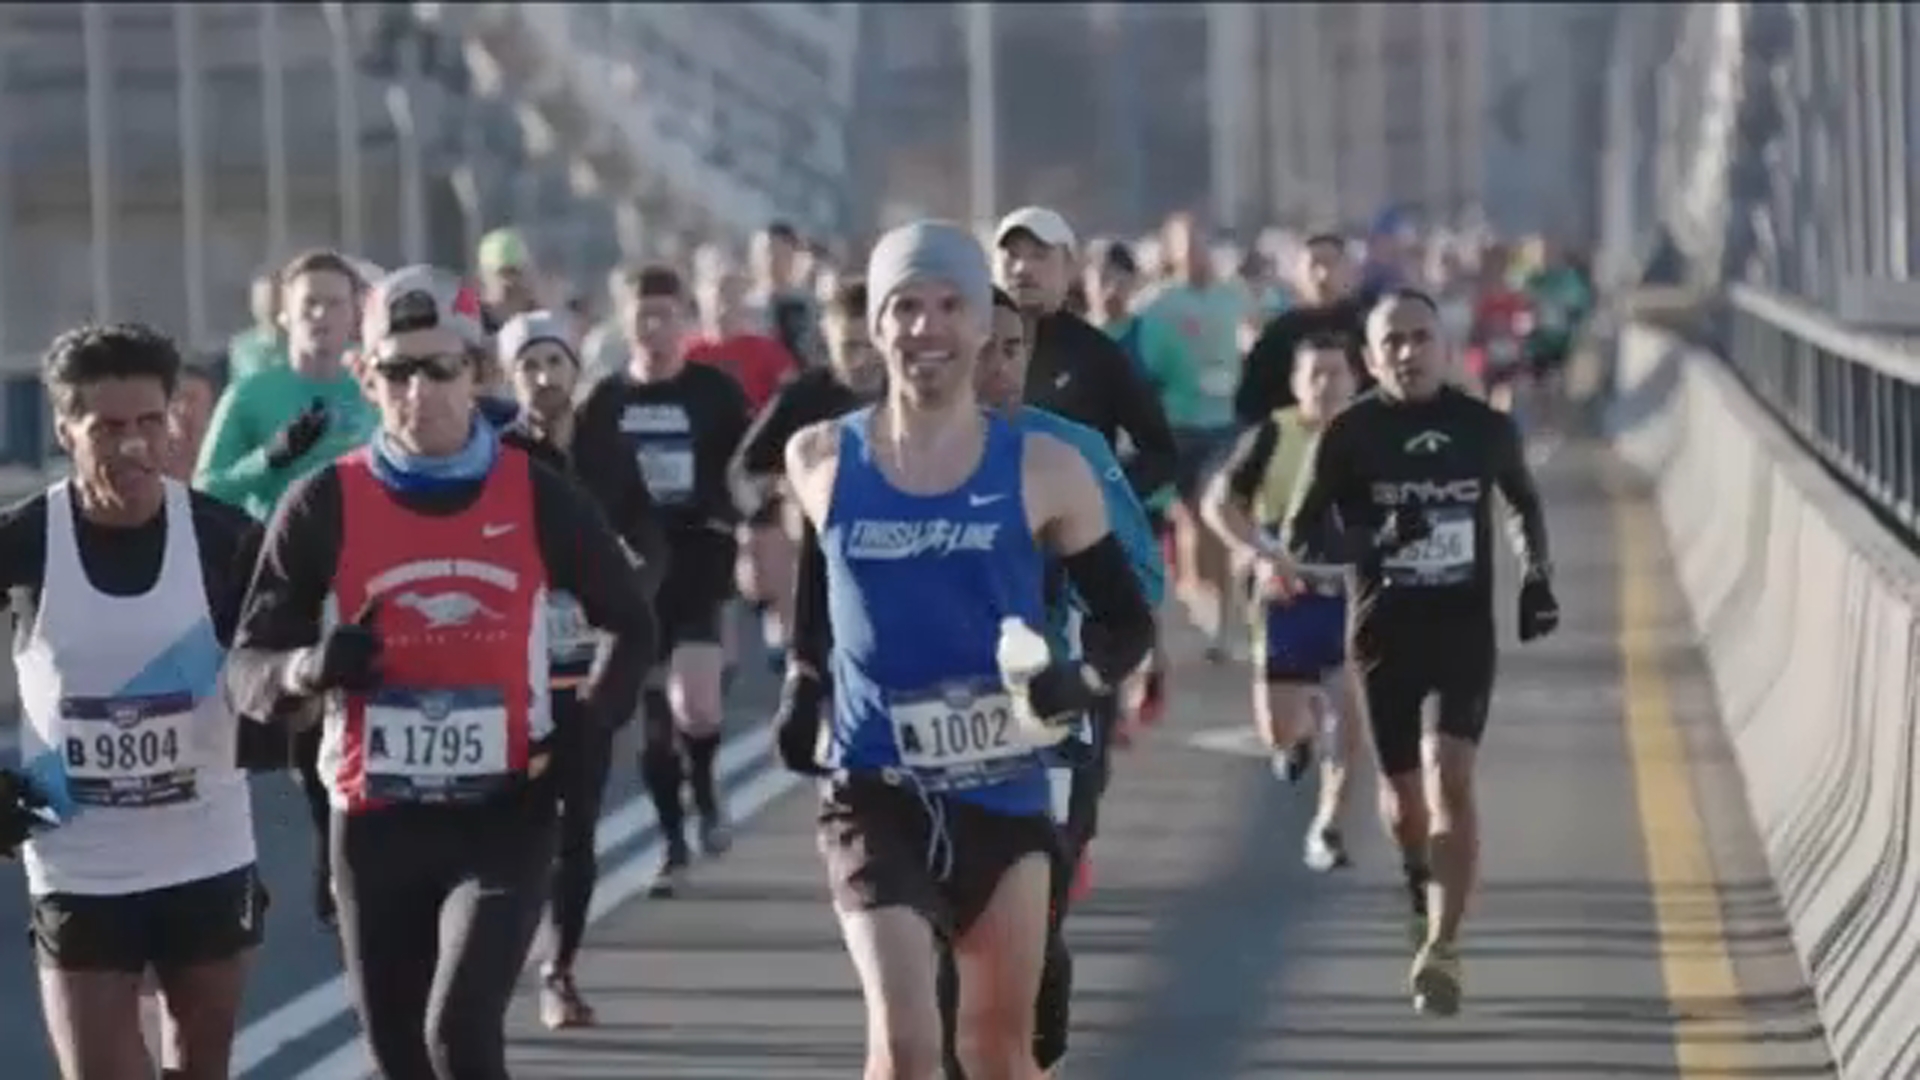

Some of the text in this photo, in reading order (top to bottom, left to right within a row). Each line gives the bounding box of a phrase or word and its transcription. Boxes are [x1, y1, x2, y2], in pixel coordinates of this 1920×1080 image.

[847, 519, 1001, 559] FINISH LINE
[66, 726, 180, 770] B 9804
[369, 723, 484, 766] A 1795
[900, 707, 1010, 757] A 1002
